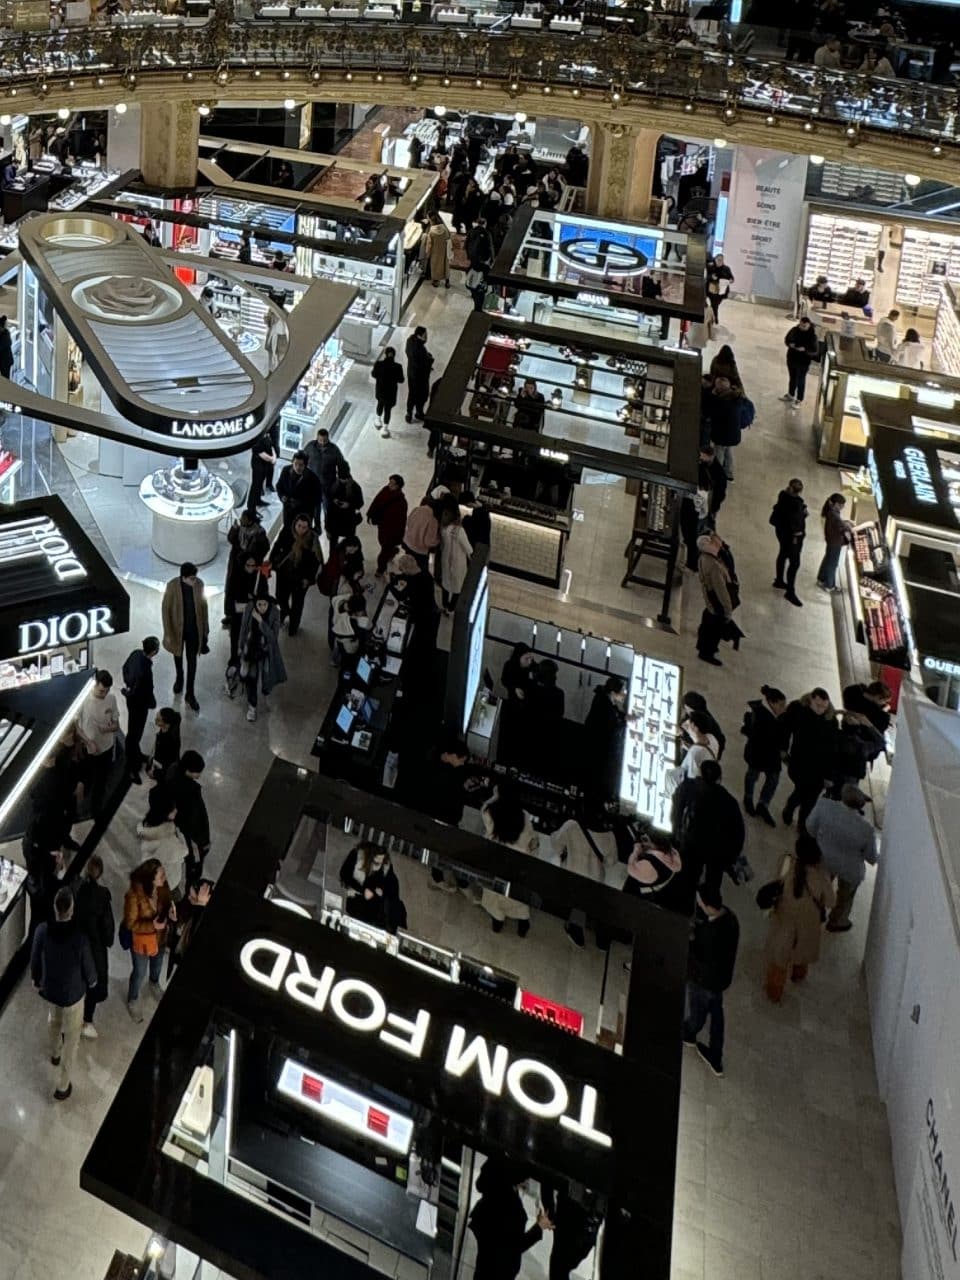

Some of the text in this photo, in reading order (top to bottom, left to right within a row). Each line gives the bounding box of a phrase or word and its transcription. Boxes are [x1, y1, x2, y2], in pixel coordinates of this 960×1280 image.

[903, 448, 938, 504] GUERLAIN
[32, 519, 88, 582] DIOR
[18, 607, 115, 653] DIOR
[240, 938, 614, 1148] TOM FORD
[926, 1097, 957, 1263] CHANEL
